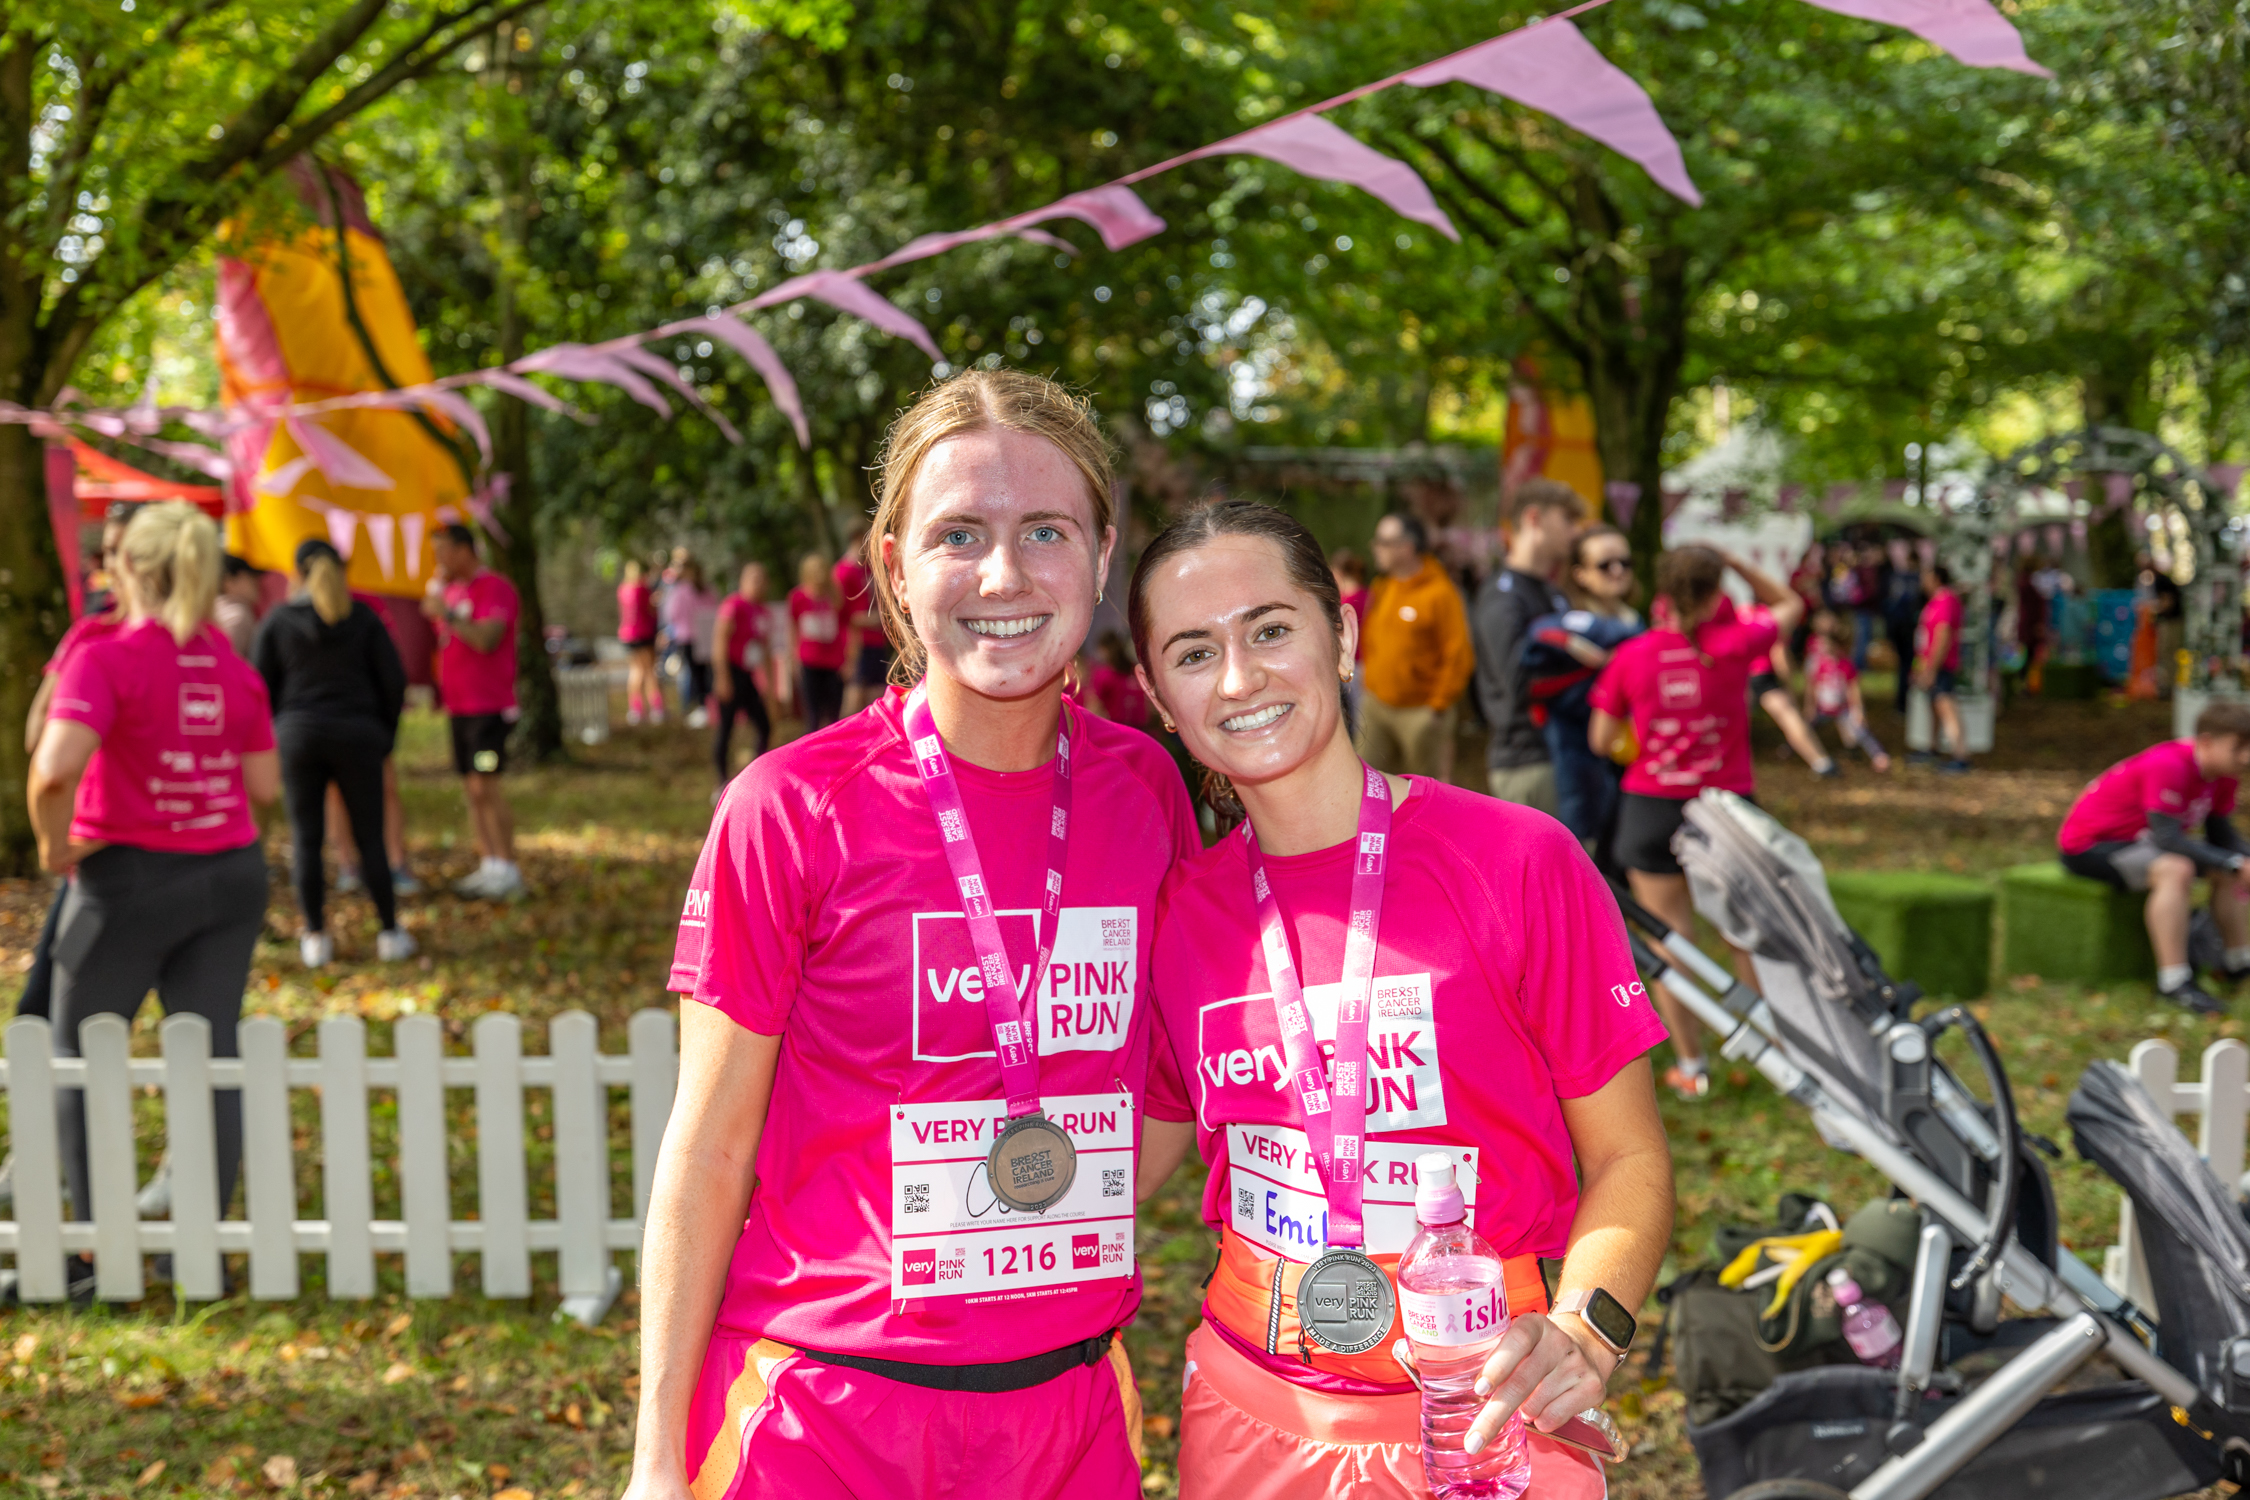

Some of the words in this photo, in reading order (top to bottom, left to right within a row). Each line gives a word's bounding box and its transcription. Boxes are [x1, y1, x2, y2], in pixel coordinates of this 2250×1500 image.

[929, 757, 939, 775] very
[945, 810, 959, 842] CANCER
[952, 808, 965, 841] IRELAND
[1368, 835, 1376, 852] PINK
[1366, 854, 1376, 873] very
[966, 878, 976, 895] PINK
[974, 878, 982, 894] RUN
[974, 897, 983, 917] very
[1101, 918, 1131, 929] BREAST
[1102, 929, 1131, 938] CANCER
[1103, 938, 1131, 947] IRELAND
[981, 955, 993, 989] BREAST
[987, 953, 1000, 987] CANCER
[994, 952, 1006, 986] IRELAND
[1050, 961, 1129, 998] PINK
[1377, 986, 1420, 999] BREAST
[1348, 1000, 1357, 1021] very
[1377, 997, 1421, 1009] CANCER
[1051, 1001, 1121, 1038] RUN
[1378, 1007, 1422, 1018] IRELAND
[1005, 1024, 1013, 1042] PINK
[1012, 1025, 1020, 1042] RUN
[1011, 1045, 1020, 1064] very
[1203, 1044, 1291, 1092] very
[1316, 1031, 1427, 1076] PNK
[1304, 1071, 1316, 1090] very
[1336, 1061, 1345, 1096] BREAST
[1343, 1061, 1351, 1096] CANCER
[1305, 1095, 1315, 1111] RUN
[1312, 1093, 1322, 1111] PINK
[911, 1118, 986, 1144] VERY
[1063, 1111, 1117, 1135] RUN
[1019, 1121, 1034, 1130] PINK
[1035, 1121, 1050, 1130] RUN
[1241, 1131, 1297, 1169] VERY
[1010, 1150, 1051, 1168] BREAST
[1012, 1160, 1053, 1177] CANCER
[1013, 1168, 1055, 1184] IRELAND
[1342, 1160, 1351, 1180] very
[1030, 1202, 1047, 1211] 2023
[1027, 1214, 1047, 1222] SUPPORT
[1073, 1245, 1098, 1258] very
[1101, 1242, 1125, 1253] PINK
[938, 1258, 966, 1270] PINK
[982, 1241, 1057, 1277] 1216
[1102, 1253, 1123, 1264] RUN
[1312, 1258, 1330, 1270] VERY
[1329, 1254, 1345, 1262] PINK
[1346, 1254, 1361, 1263] RUN
[1361, 1259, 1377, 1273] 2023
[904, 1260, 934, 1275] very
[938, 1269, 963, 1281] RUN
[979, 1295, 997, 1303] STARTS
[1315, 1297, 1344, 1311] very
[1349, 1297, 1379, 1309] PINK
[1349, 1308, 1376, 1320] RUN
[1408, 1310, 1436, 1323] BREAST
[1410, 1317, 1437, 1331] CANCER
[1309, 1328, 1330, 1348] MADE
[1341, 1326, 1387, 1353] DIFFERENCE
[1479, 1328, 1492, 1339] IRISH
